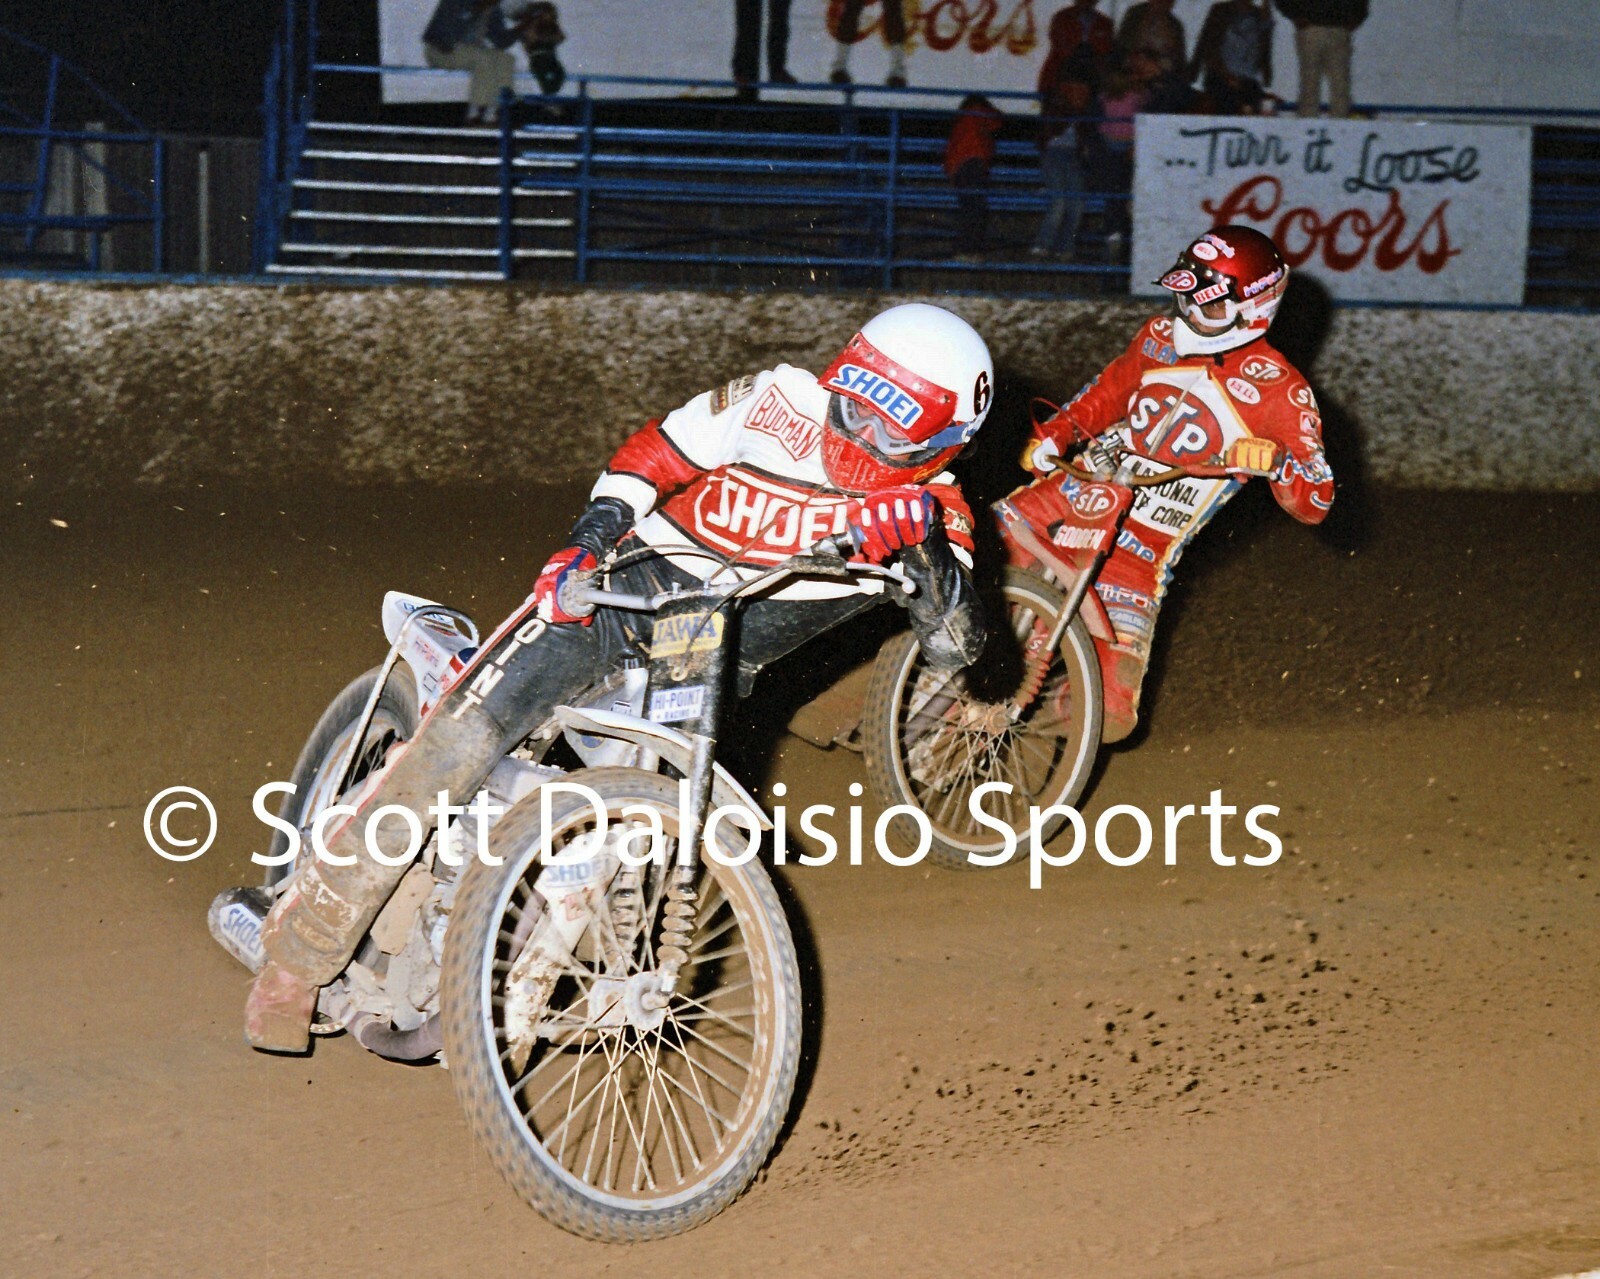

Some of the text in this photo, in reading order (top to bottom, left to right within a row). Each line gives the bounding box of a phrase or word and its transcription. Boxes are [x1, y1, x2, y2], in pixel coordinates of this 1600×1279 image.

[826, 0, 1037, 55] ors
[1304, 128, 1333, 174] it
[1343, 132, 1480, 194] Loose
[1202, 174, 1462, 274] Coors
[1194, 283, 1227, 304] BELL
[973, 370, 991, 416] 6
[1230, 379, 1256, 401] BELL
[1244, 361, 1282, 381] STP
[832, 365, 920, 427] SHOEI
[749, 390, 819, 458] BUDMAN
[1130, 394, 1210, 458] STP
[705, 479, 848, 550] SHOEI
[1075, 488, 1110, 512] STP
[1150, 505, 1192, 529] CORP
[651, 616, 717, 646] JAWA
[654, 687, 702, 710] HI-POINT
[223, 907, 264, 955] SHOE
